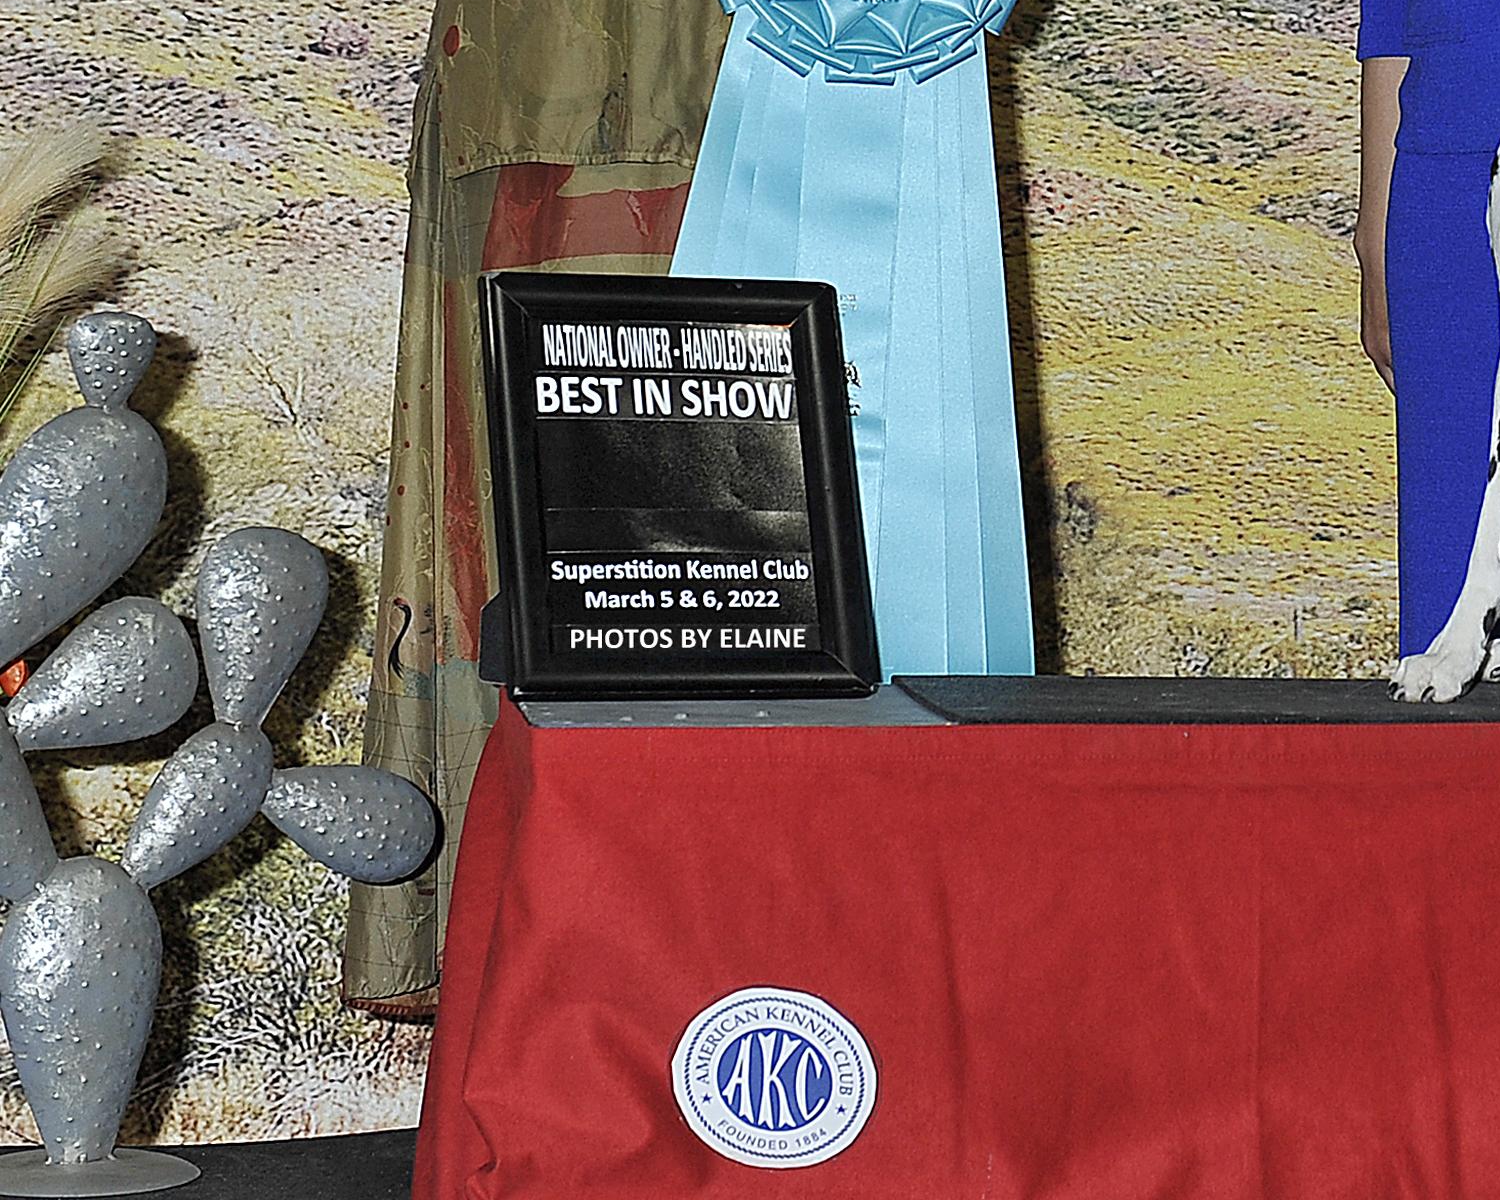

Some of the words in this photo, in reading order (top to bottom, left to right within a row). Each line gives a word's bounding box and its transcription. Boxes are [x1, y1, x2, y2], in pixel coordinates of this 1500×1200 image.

[543, 324, 618, 367] NATIONAL
[617, 326, 672, 368] OWNER
[680, 328, 747, 371] HANDLED
[747, 328, 793, 374] SERIES
[536, 376, 623, 414] BEST
[633, 378, 672, 415] IN
[681, 379, 793, 419] SHOW
[551, 559, 681, 584] Superstition
[686, 559, 758, 580] Kennel
[763, 559, 809, 580] Club
[585, 590, 655, 608] March
[660, 590, 673, 608] 5
[679, 590, 698, 608] &
[702, 590, 722, 611] 6,
[727, 590, 780, 608] 2022
[570, 628, 673, 649] PHOTOS
[681, 628, 712, 648] BY
[720, 628, 806, 648] ELAINE
[695, 1006, 760, 1085] AMERICAN
[765, 1006, 837, 1051] KENNEL
[833, 1049, 855, 1097] CLUB
[721, 1030, 825, 1130] AKC
[717, 1119, 788, 1151] FOUNDED
[795, 1128, 828, 1148] 1884
